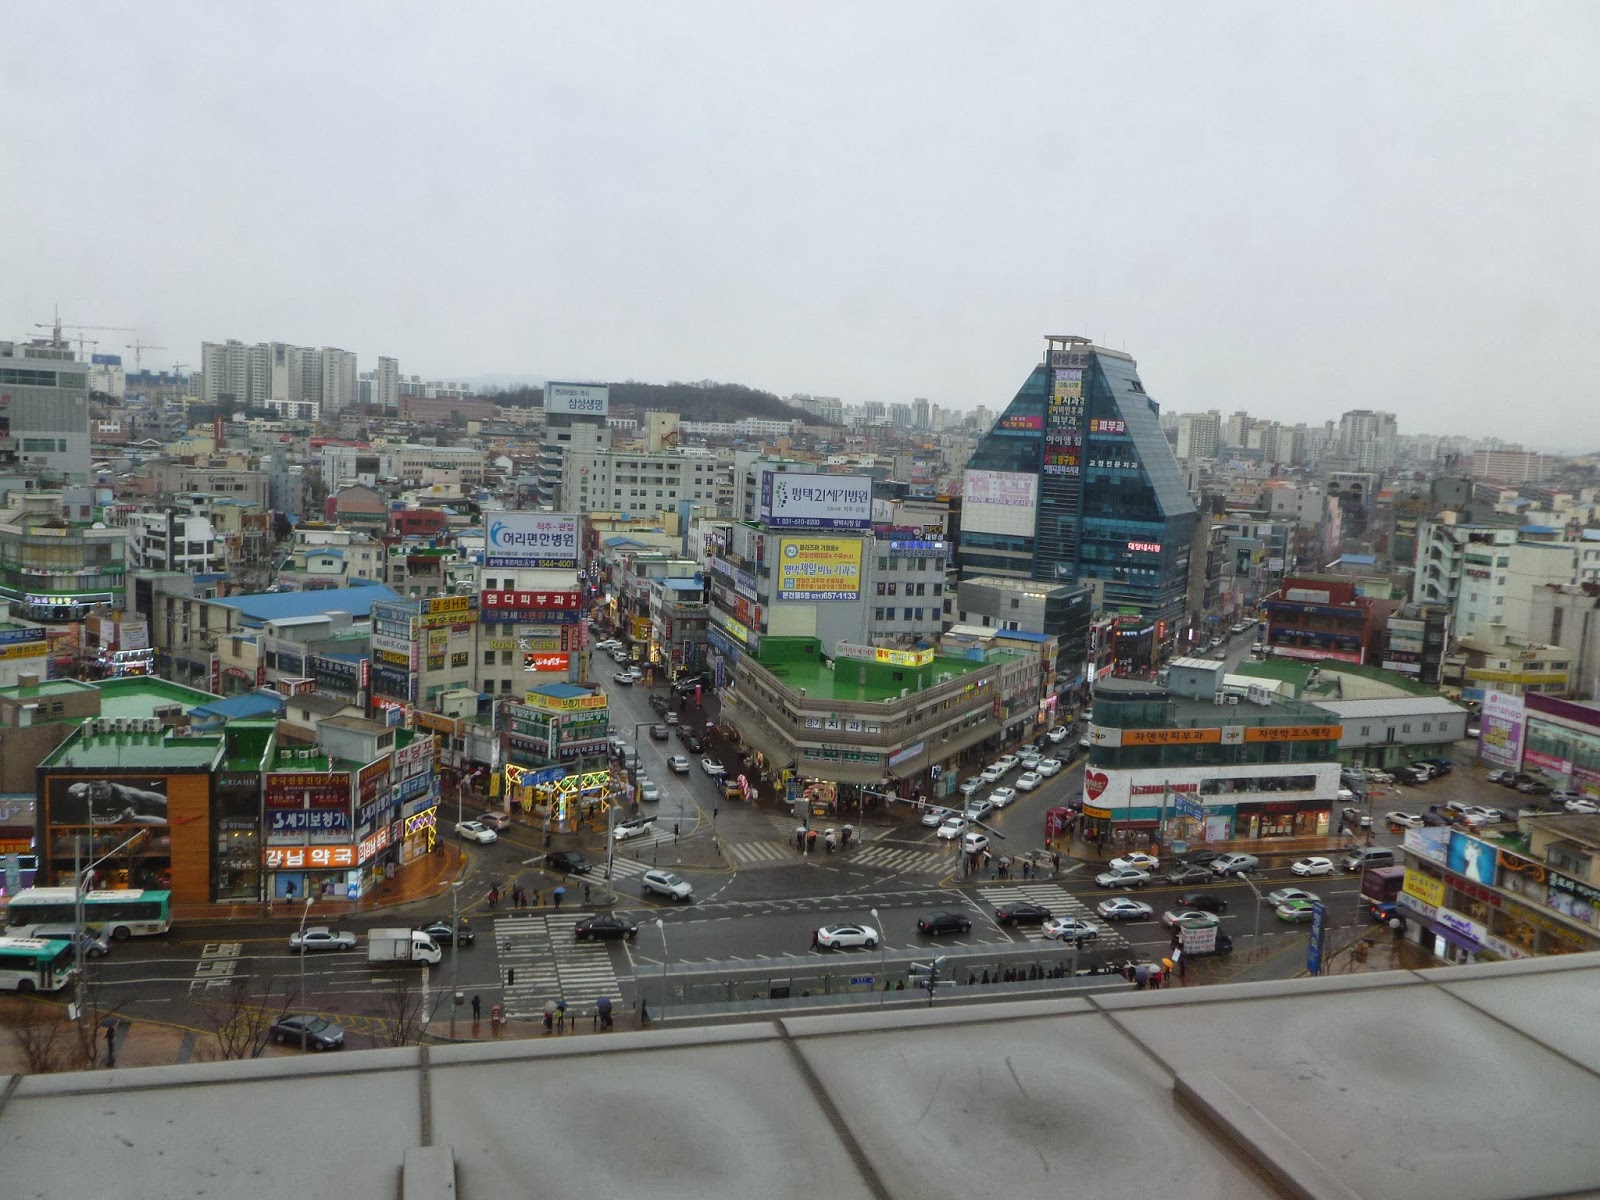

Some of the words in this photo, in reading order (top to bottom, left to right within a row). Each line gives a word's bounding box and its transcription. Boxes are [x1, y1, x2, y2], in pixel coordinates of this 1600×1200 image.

[569, 399, 603, 411] 삼성생명
[1100, 421, 1125, 431] 피부과
[792, 487, 868, 504] 평택21세기병원
[503, 532, 574, 547] 허리편한병원
[487, 594, 564, 605] 엠디피부과
[490, 640, 517, 650] Rush
[531, 640, 558, 650] Cash
[1090, 732, 1106, 740] CNP
[1135, 731, 1203, 742] 차앤박피부과
[398, 739, 433, 763] 전당포
[266, 848, 353, 866] 강남약국
